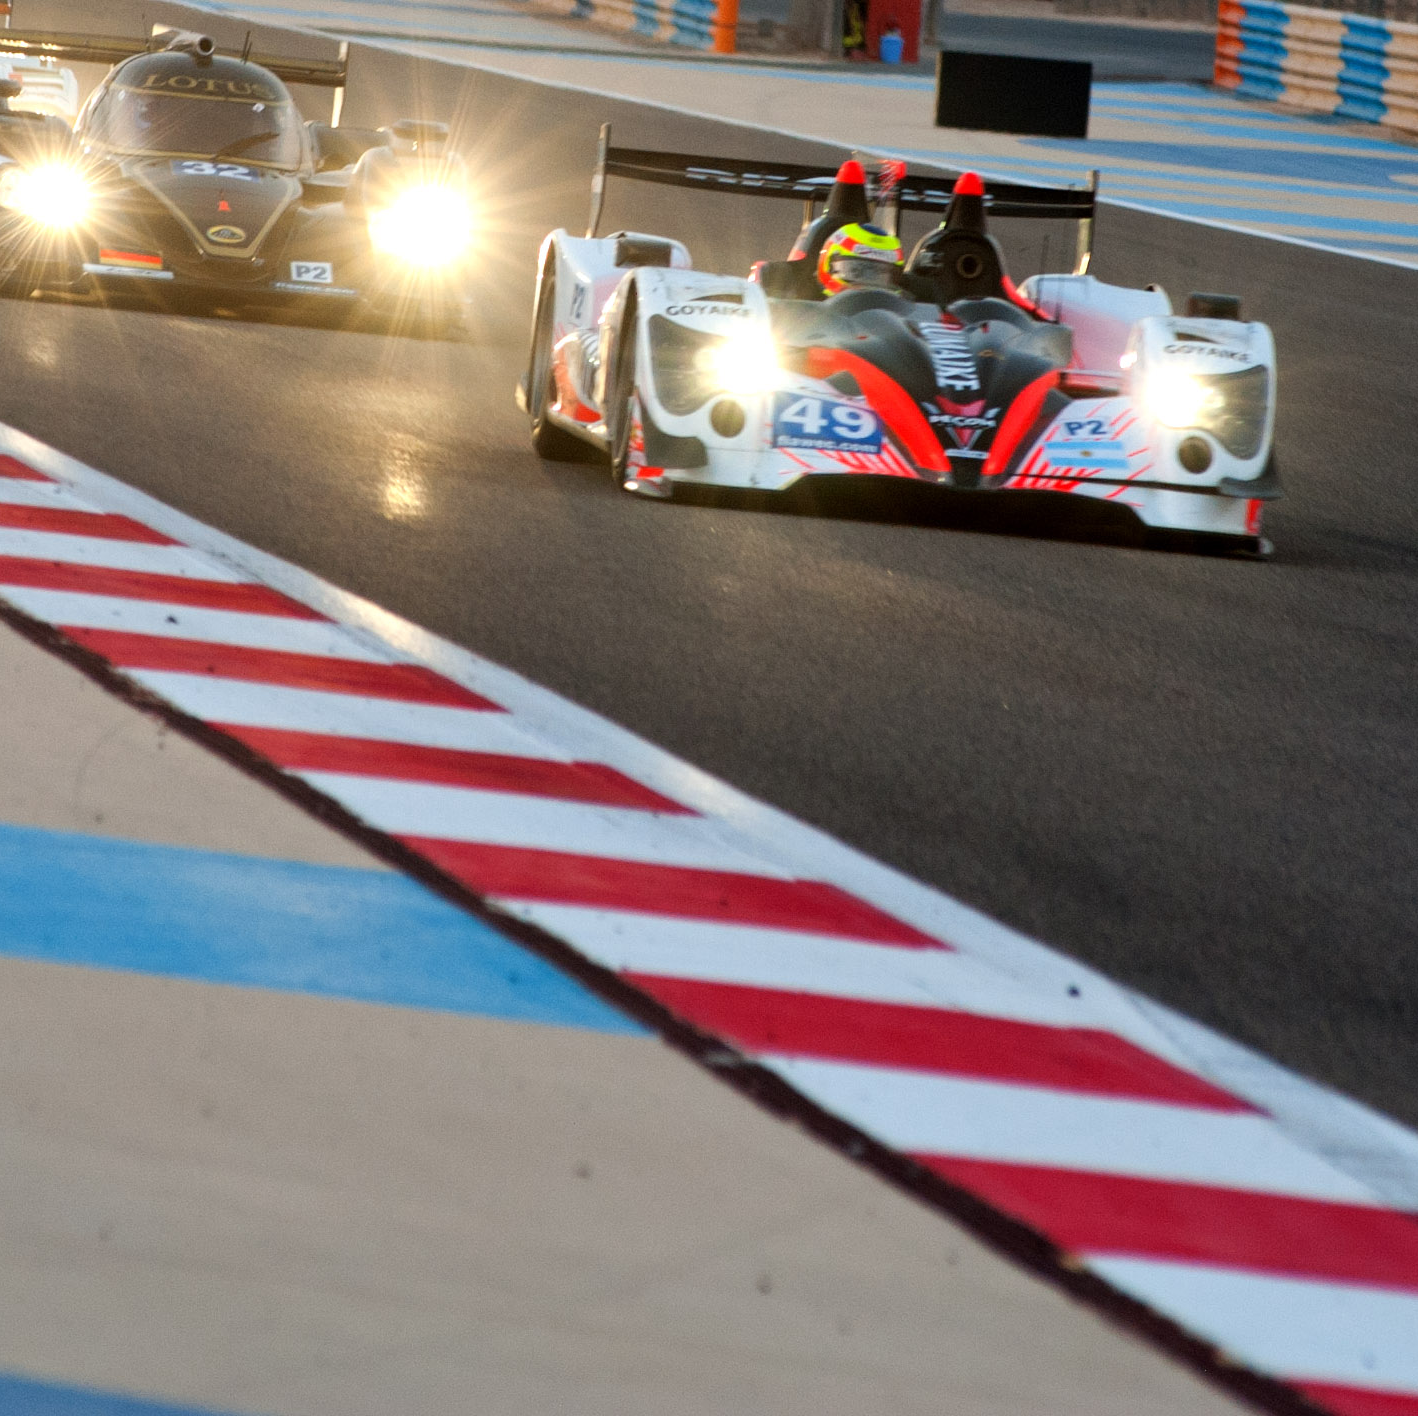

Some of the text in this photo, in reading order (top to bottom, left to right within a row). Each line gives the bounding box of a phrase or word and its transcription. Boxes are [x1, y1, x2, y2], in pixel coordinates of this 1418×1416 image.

[142, 74, 276, 99] LOTUS
[180, 161, 253, 181] 32
[295, 264, 328, 281] P2
[780, 397, 878, 440] 49
[1064, 420, 1108, 436] P2
